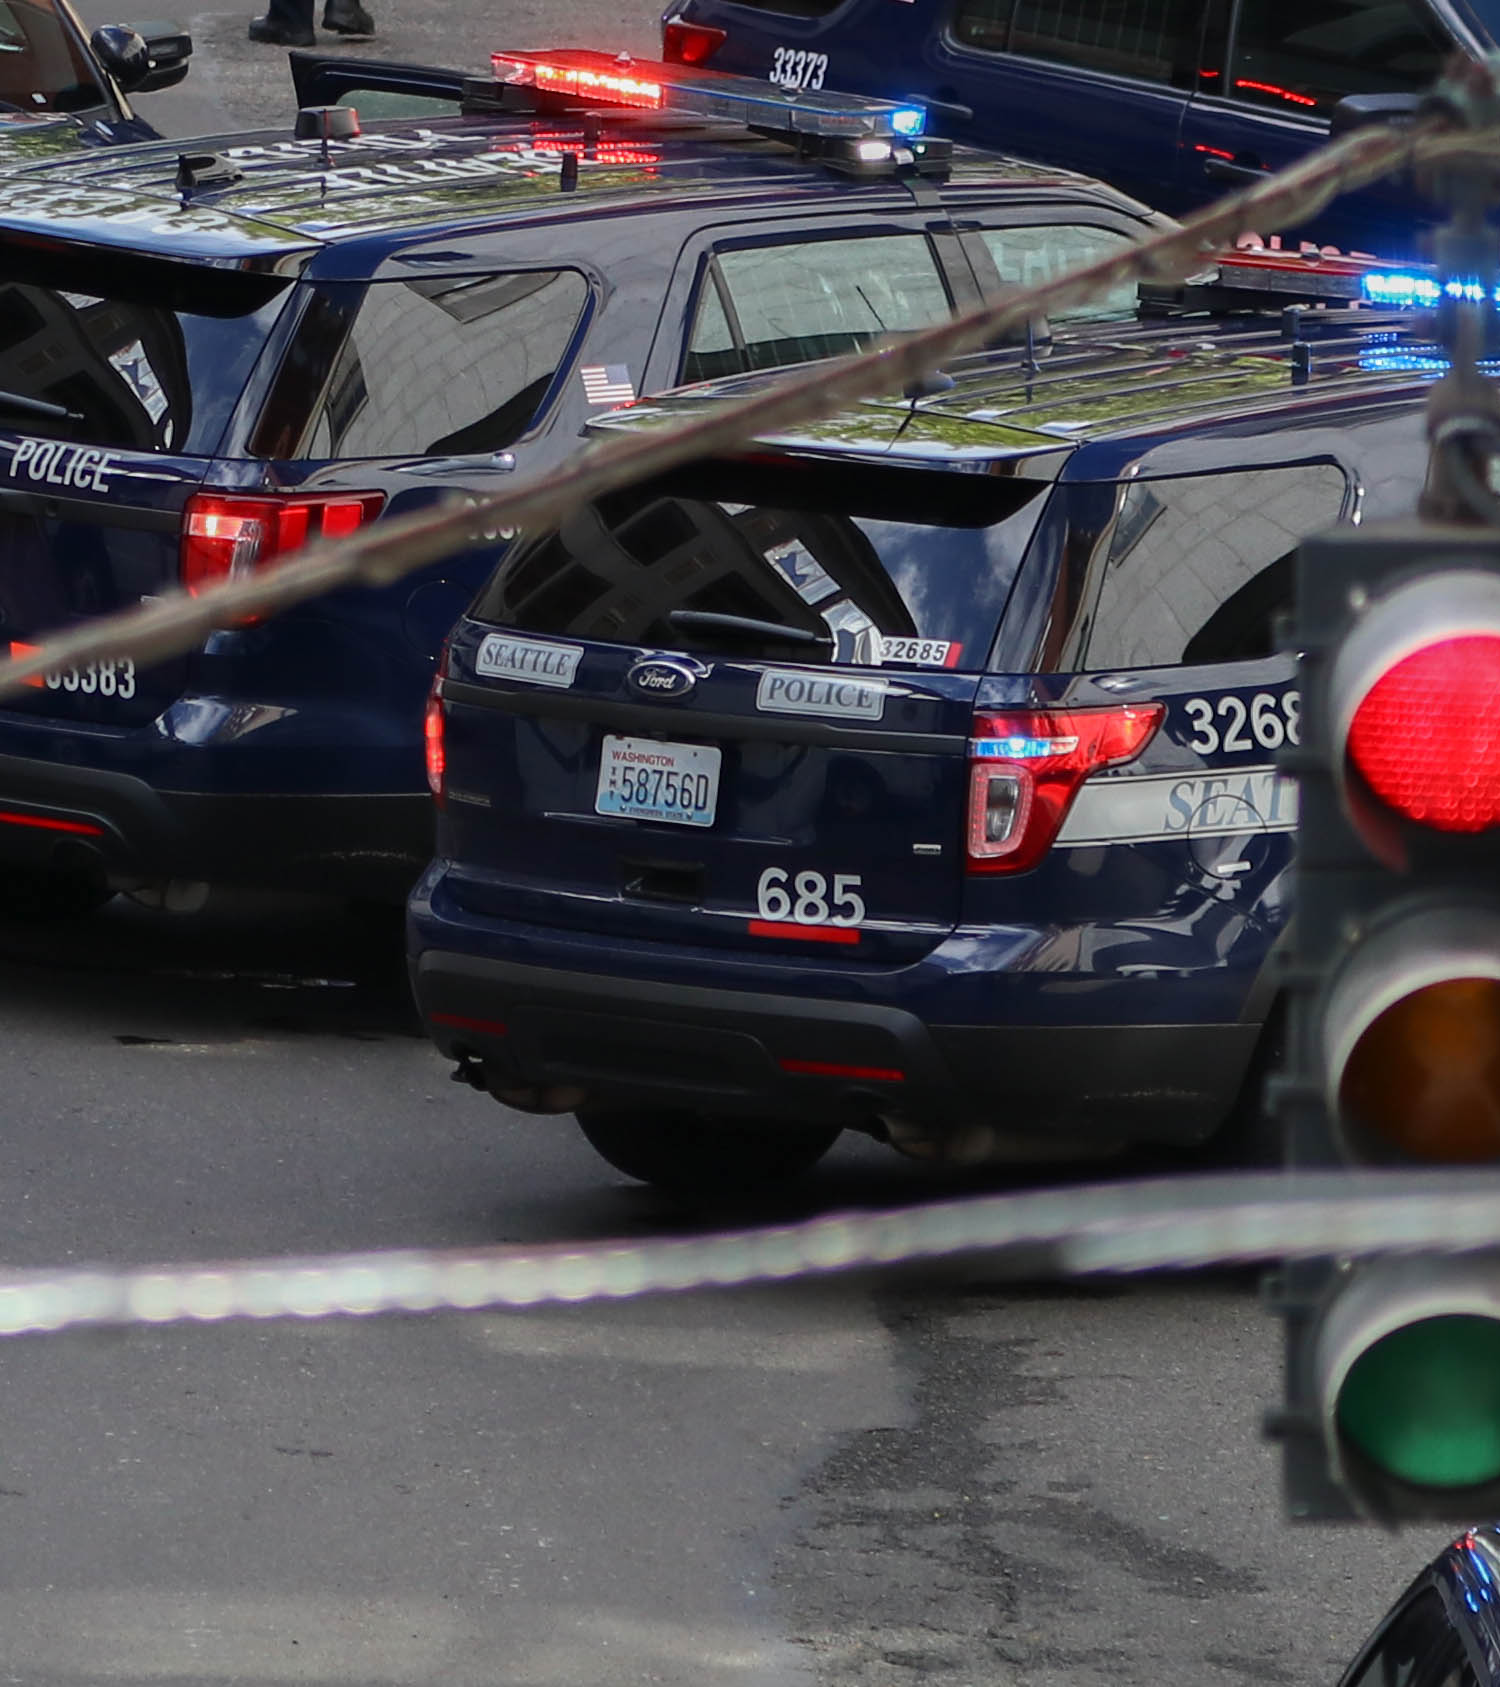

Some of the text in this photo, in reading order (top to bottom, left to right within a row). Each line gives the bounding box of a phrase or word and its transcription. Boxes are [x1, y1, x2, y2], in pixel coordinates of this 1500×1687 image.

[770, 48, 829, 90] 33373
[9, 439, 120, 493] POLICE
[482, 642, 872, 709] SEATTLE POLICE
[881, 639, 947, 663] 32685
[1184, 691, 1301, 755] 3268
[611, 750, 675, 768] WASHINGTON
[621, 767, 710, 812] 58756D
[1164, 773, 1290, 833] SEAT
[757, 866, 866, 928] 685
